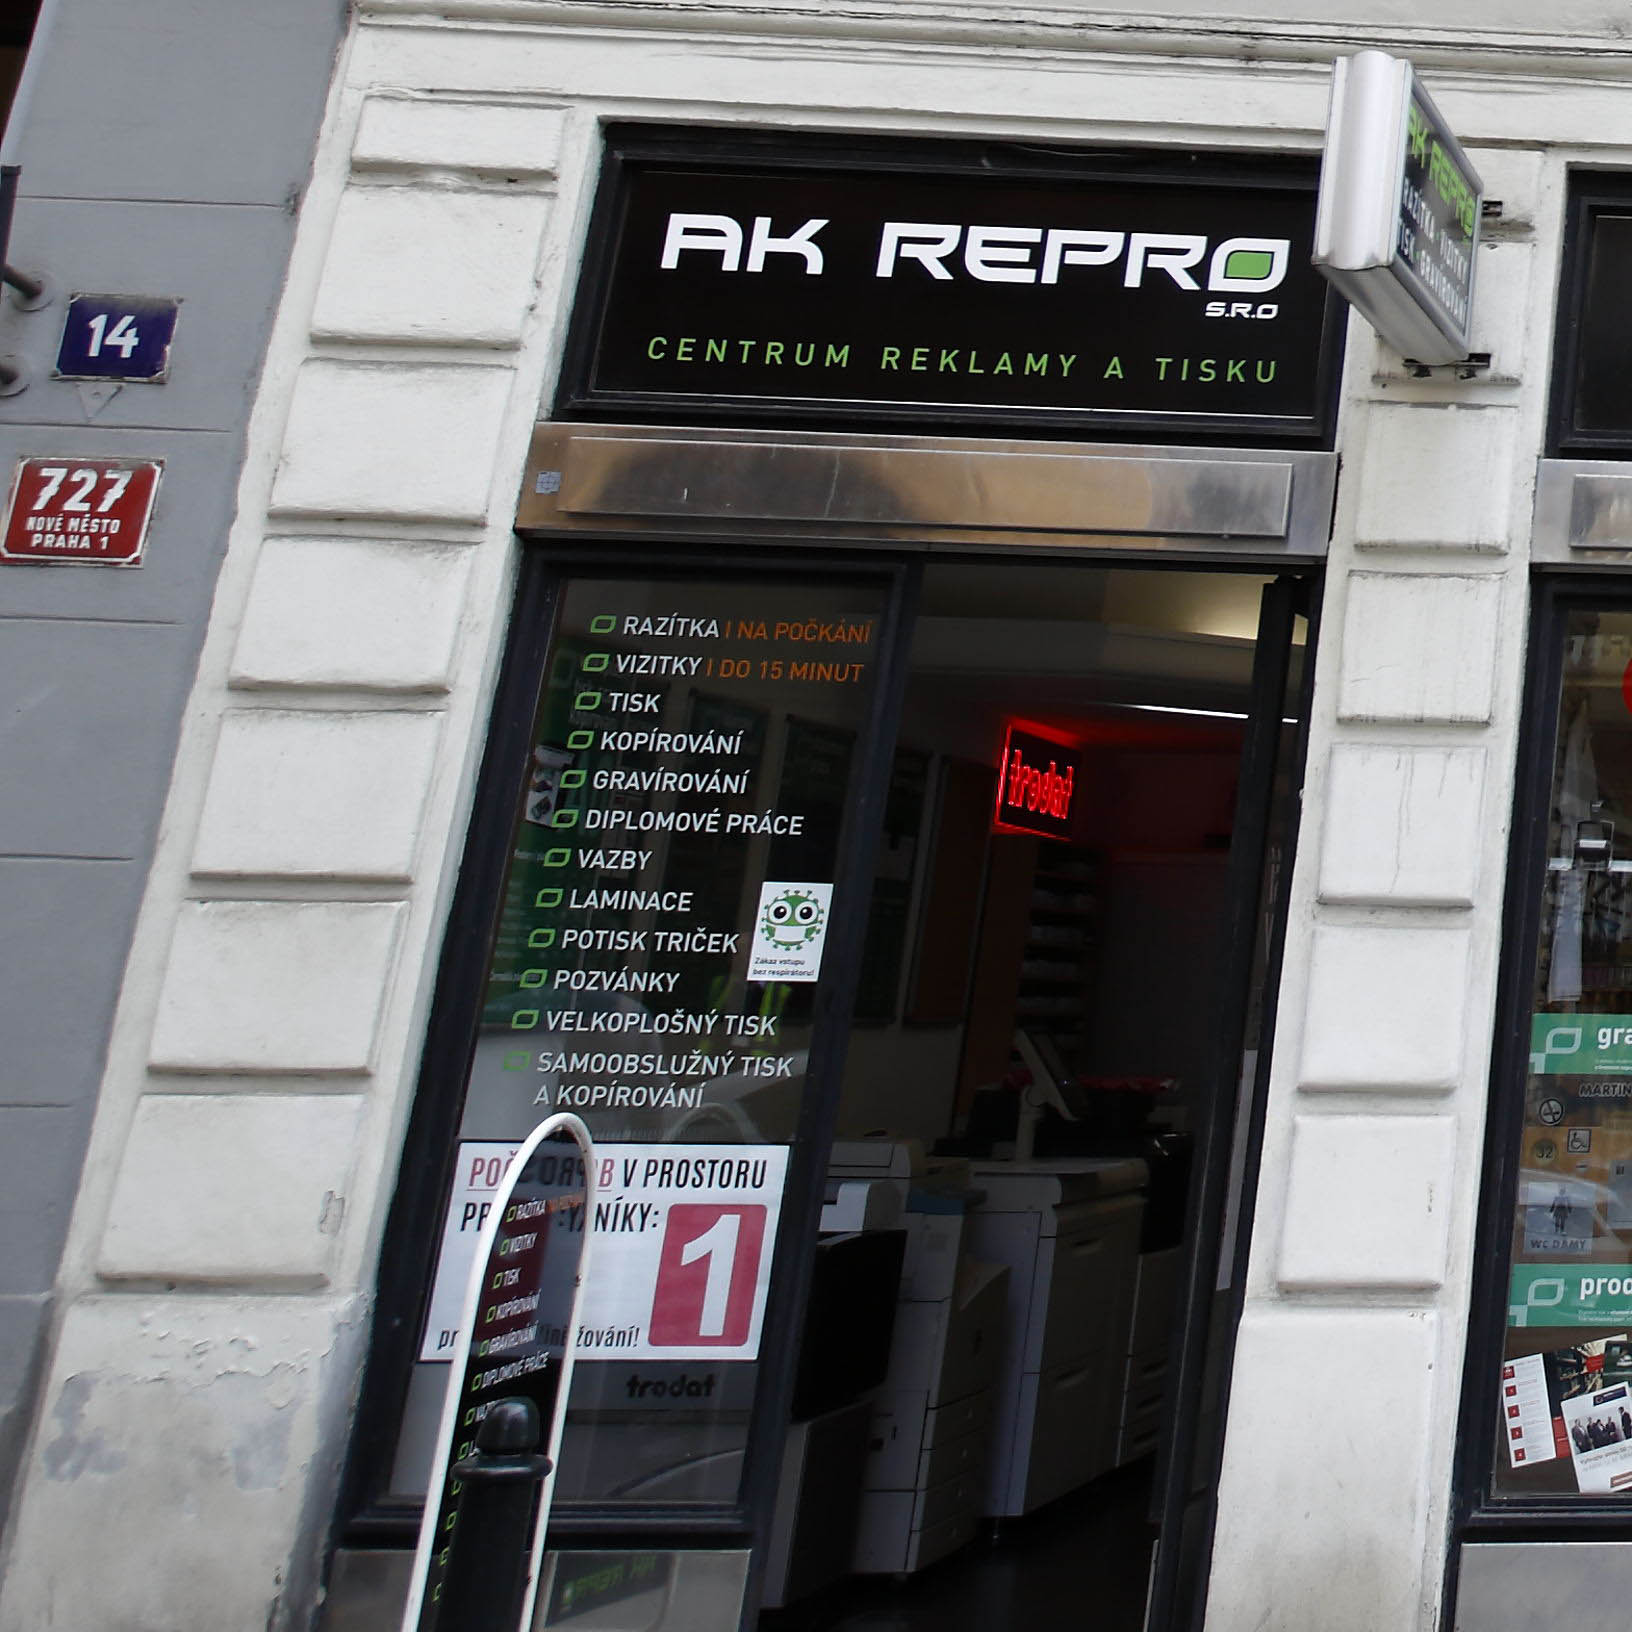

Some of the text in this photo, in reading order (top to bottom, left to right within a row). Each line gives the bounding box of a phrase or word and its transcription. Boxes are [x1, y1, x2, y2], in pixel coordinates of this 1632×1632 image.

[660, 213, 1291, 294] AK REPRO
[88, 314, 139, 358] 14
[647, 336, 1277, 383] CENTRUM REKLAMY A TISKU
[32, 468, 133, 513] 727
[26, 514, 64, 533] NOVÉ
[30, 533, 110, 550] PRAHA 1
[624, 612, 873, 643] RAZÍTKA NA POČKÁNÍ
[616, 654, 864, 682] VIZITKY DO 15 MINUT
[609, 692, 661, 713] TISK
[600, 728, 744, 755] KOPÍROVÁNÍ
[593, 767, 750, 794] GRAVÍROVÁNÍ
[585, 808, 804, 836] DIPLOMOVÉ PRÁCE
[578, 849, 653, 870] VAZBY
[569, 889, 694, 913] LAMINACE
[561, 927, 739, 954] POTISK TRIČEK
[553, 969, 680, 993] POZVÁNKY
[546, 1007, 777, 1037] VELKOPLOŠNÝ TISK
[537, 1050, 794, 1079] SAMOOBSLUŽNÝ TISK
[533, 1080, 705, 1109] A KOPÍROVÁNÍ
[1579, 1082, 1632, 1097] MARTIN
[623, 1158, 768, 1189] V PROSTORU
[1530, 1239, 1549, 1249] WC
[681, 1213, 741, 1337] 1
[626, 1373, 718, 1399] trodat
